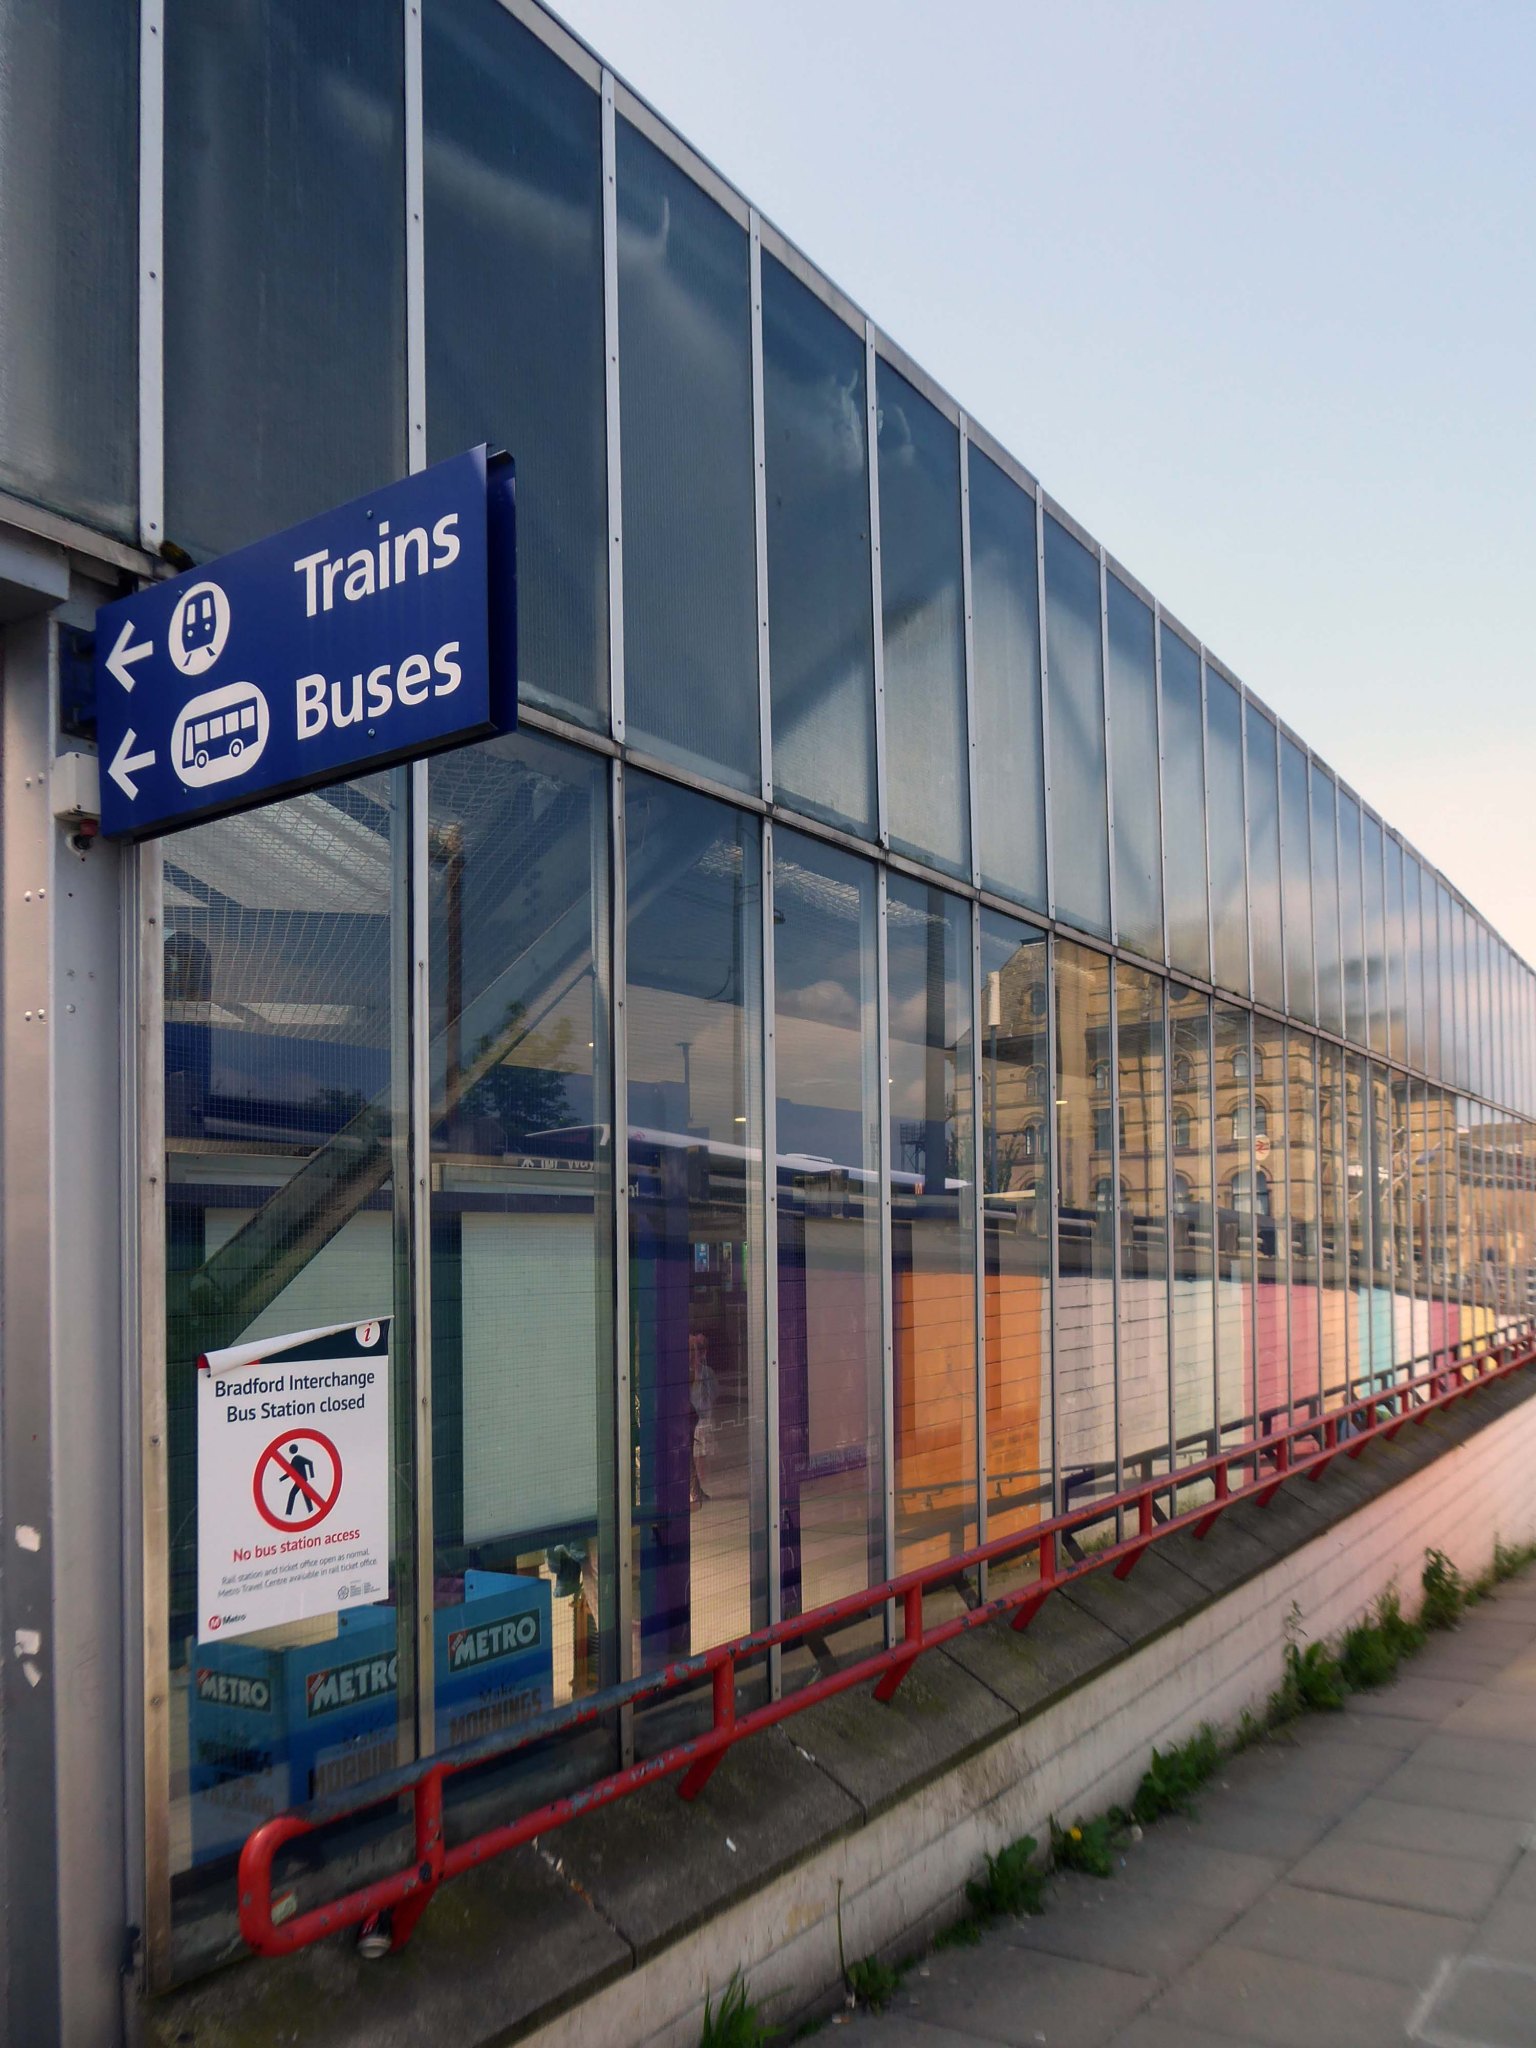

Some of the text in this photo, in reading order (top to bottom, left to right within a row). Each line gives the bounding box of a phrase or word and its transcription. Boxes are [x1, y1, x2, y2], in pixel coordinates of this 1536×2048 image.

[294, 513, 460, 618] Trains
[296, 641, 462, 740] Buses
[215, 1371, 375, 1398] Bradford Interchange
[227, 1393, 365, 1423] Bus Station closed
[233, 1529, 360, 1562] No bus station access
[217, 1587, 241, 1599] Metro
[241, 1581, 263, 1593] Travel
[265, 1577, 288, 1588] Centre
[289, 1570, 319, 1583] available
[321, 1568, 327, 1576] in
[329, 1564, 339, 1574] rail
[341, 1562, 358, 1572] ticket
[222, 1574, 236, 1585] Rail
[238, 1570, 263, 1582] station
[265, 1566, 278, 1577] and
[280, 1562, 298, 1573] ticket
[300, 1559, 318, 1569] office
[320, 1556, 336, 1566] open
[338, 1553, 345, 1561] as
[223, 1613, 246, 1625] Metro
[454, 1616, 537, 1667] METRO
[201, 1674, 269, 1707] METRO
